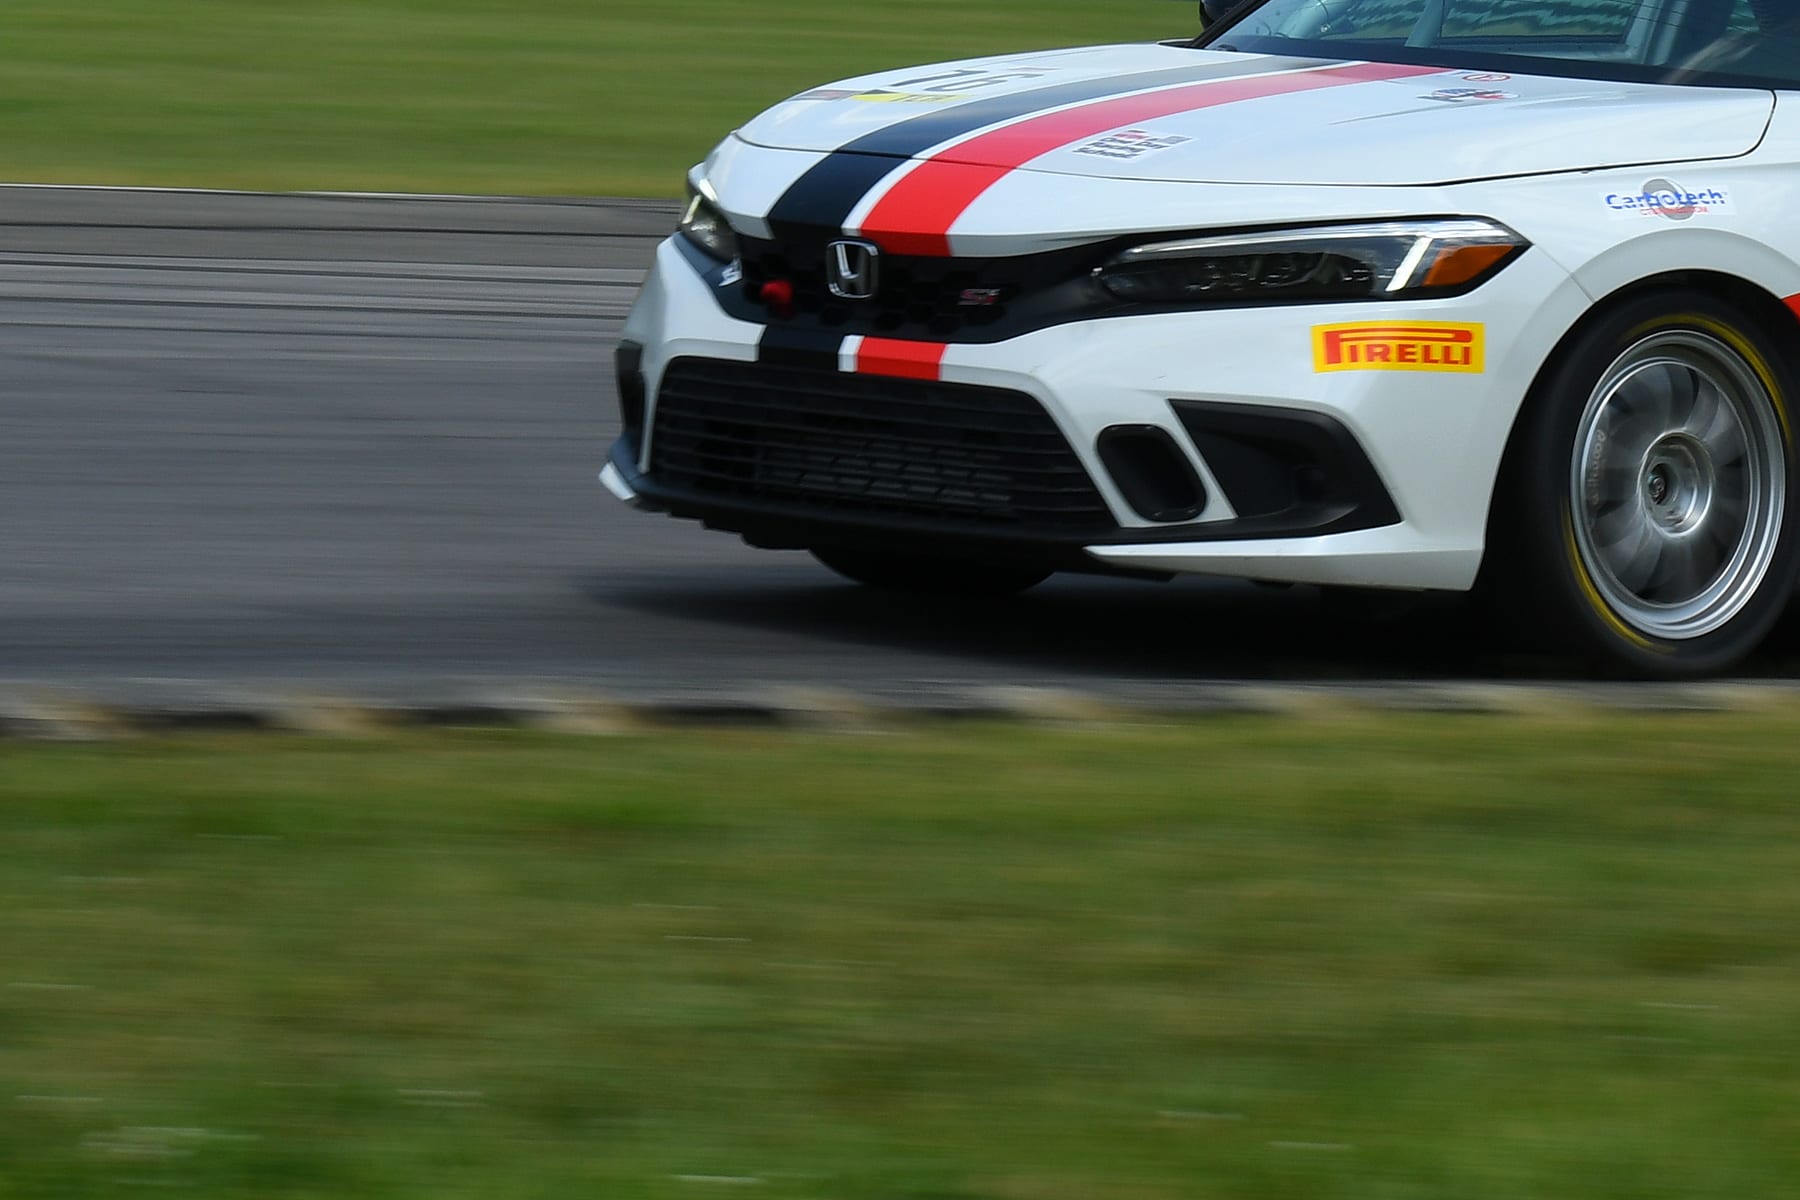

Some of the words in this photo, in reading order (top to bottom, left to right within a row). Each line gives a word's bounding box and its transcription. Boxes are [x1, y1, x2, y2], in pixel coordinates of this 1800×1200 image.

[888, 68, 1044, 92] 16
[1606, 188, 1725, 210] Carbotech
[1324, 327, 1473, 365] PIRELLI
